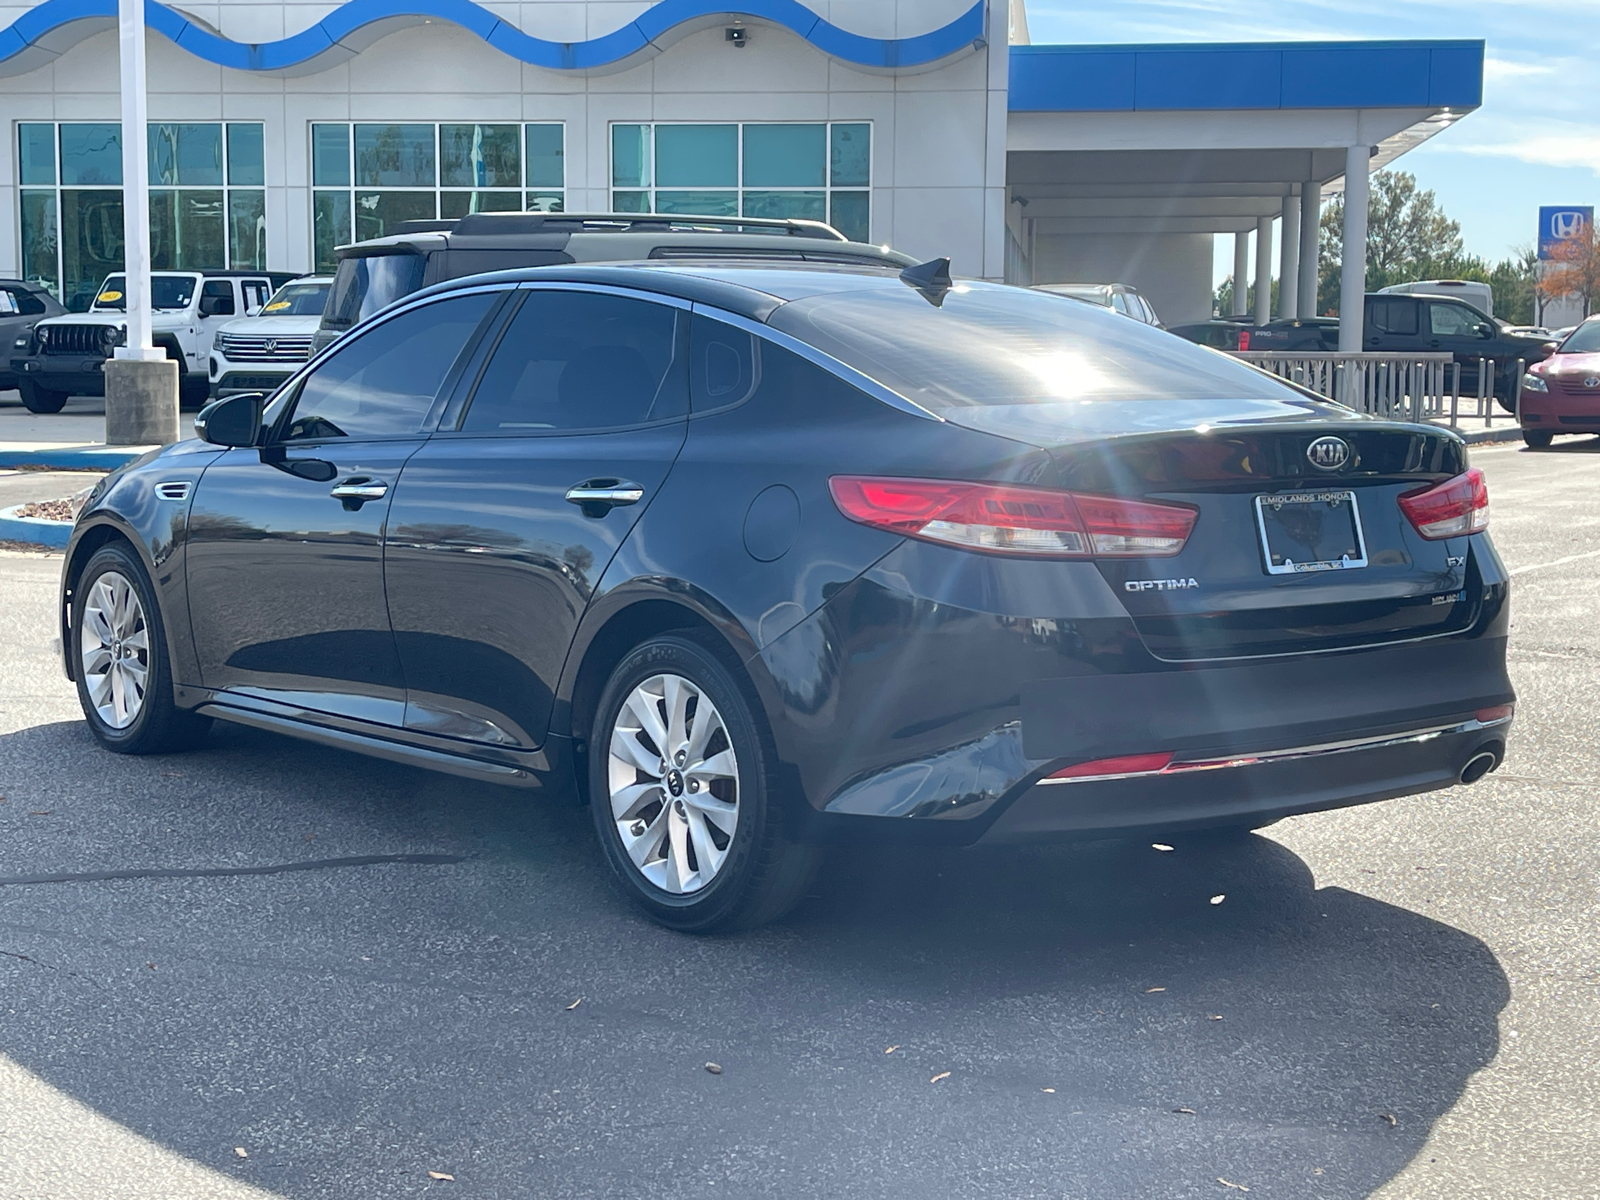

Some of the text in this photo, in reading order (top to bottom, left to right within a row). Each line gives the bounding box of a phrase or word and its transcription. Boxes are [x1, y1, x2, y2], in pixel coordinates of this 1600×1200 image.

[1315, 443, 1345, 463] KIA
[1267, 492, 1350, 504] MIDLANDS HONDA
[1447, 556, 1464, 567] EX
[1124, 577, 1200, 592] OPTIMA
[669, 772, 680, 795] KIA
